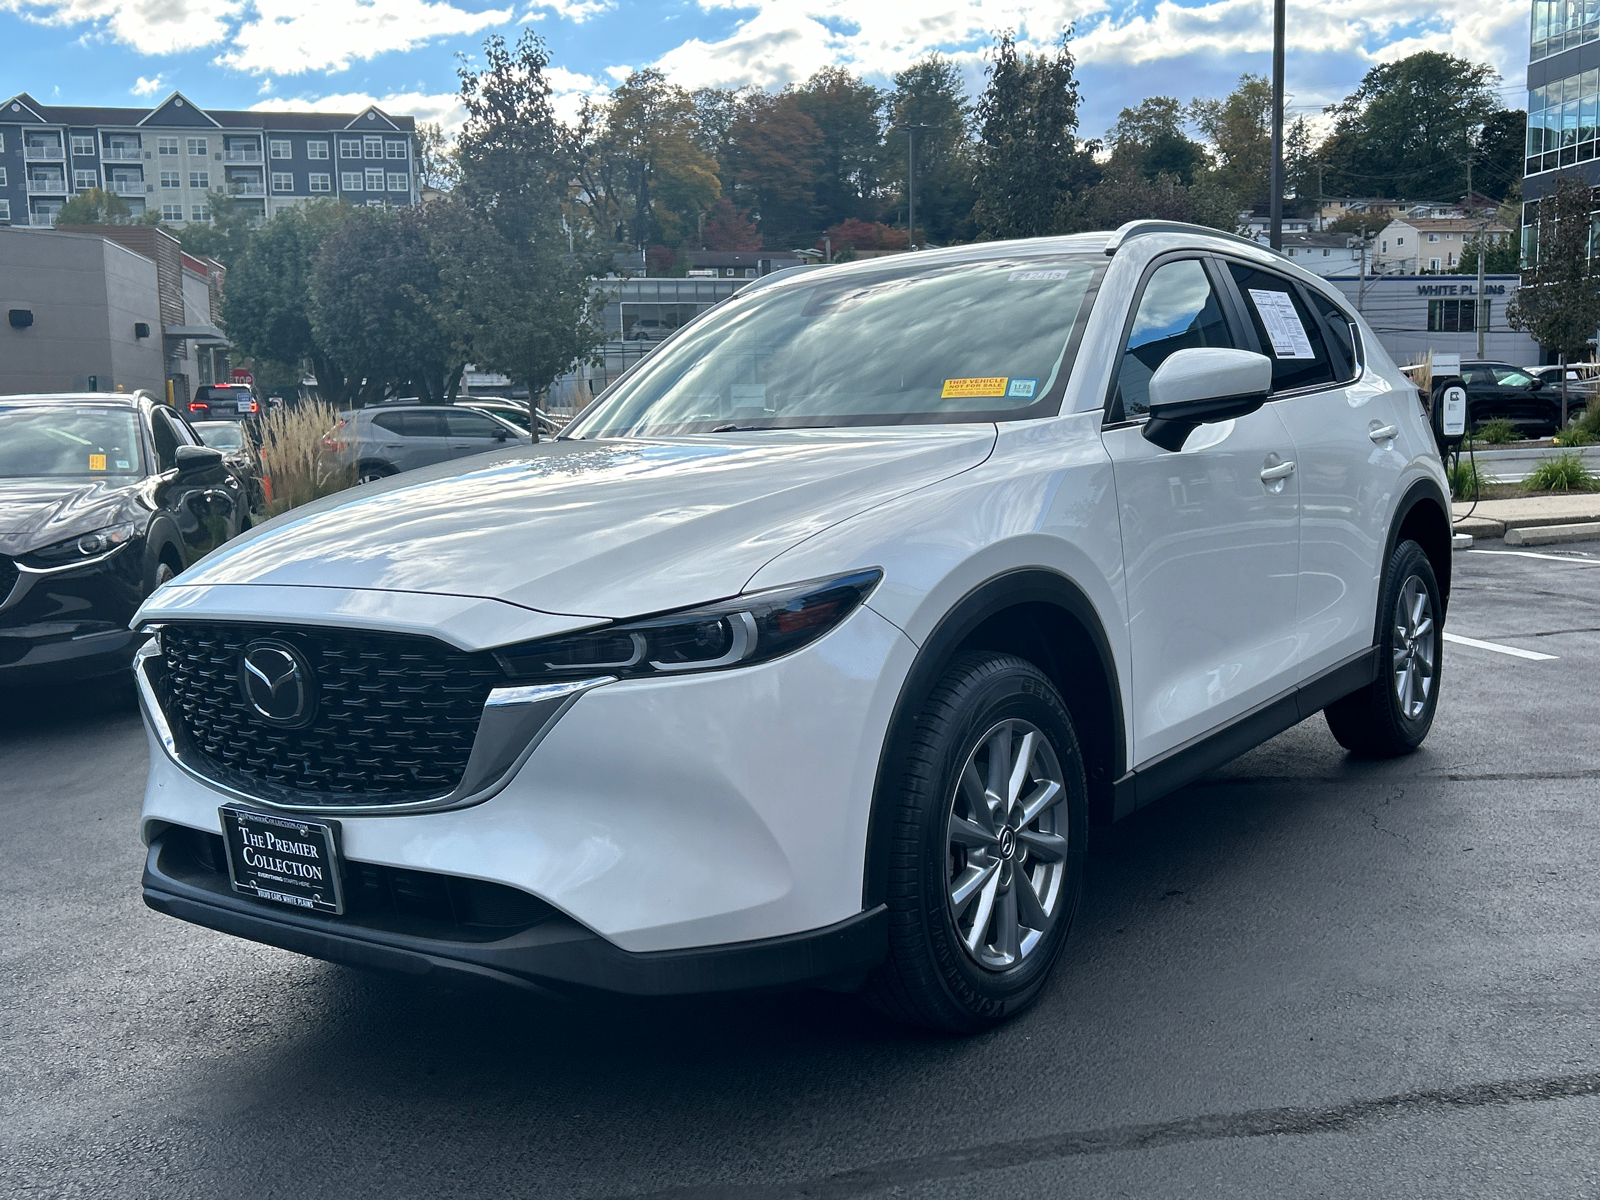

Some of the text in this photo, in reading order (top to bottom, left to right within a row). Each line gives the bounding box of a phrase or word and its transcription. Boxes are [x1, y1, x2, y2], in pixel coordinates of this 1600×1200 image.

[1417, 285, 1505, 295] WHITE PLINS
[238, 826, 320, 859] THE PREMIER
[242, 846, 323, 881] COLLECTION
[257, 889, 314, 909] VOLVO CARS WHITE PLAINS
